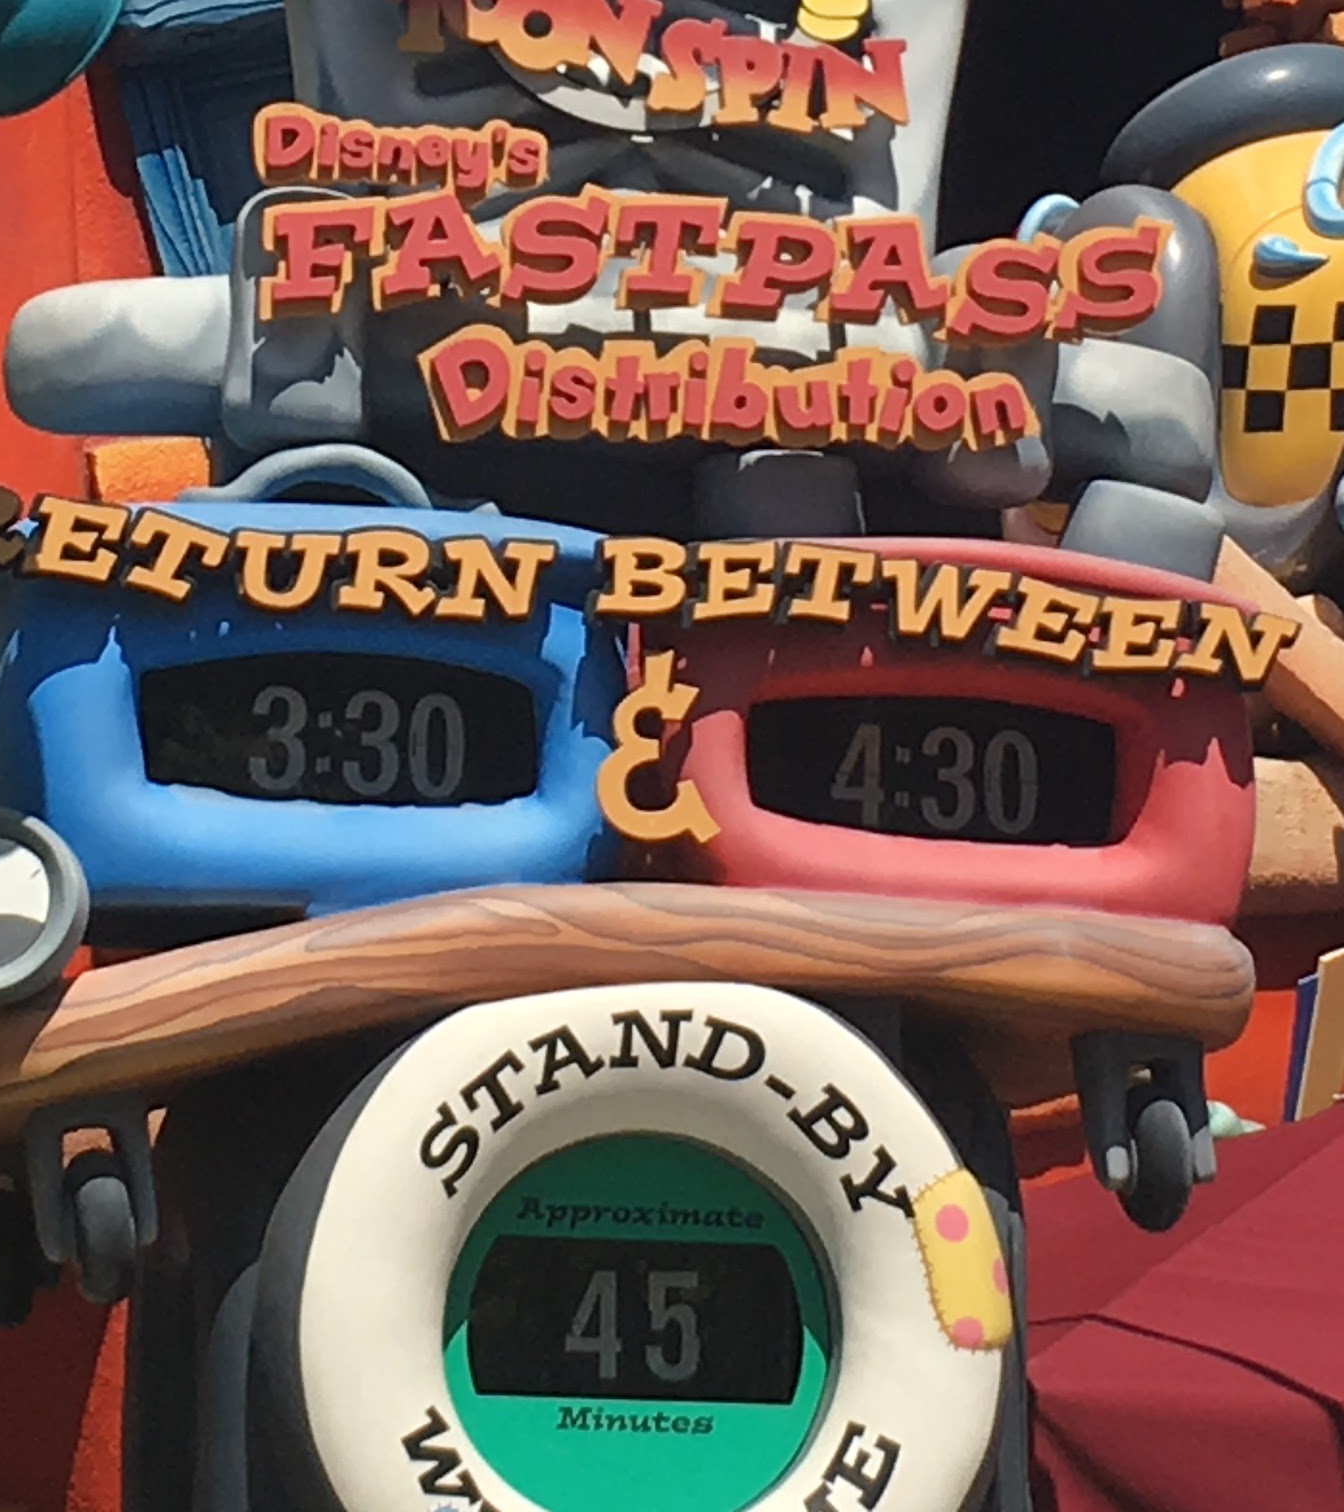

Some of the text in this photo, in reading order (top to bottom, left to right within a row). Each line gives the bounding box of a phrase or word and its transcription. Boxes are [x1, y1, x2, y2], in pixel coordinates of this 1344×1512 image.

[647, 17, 910, 133] SPIN
[256, 105, 548, 192] Disney's
[260, 186, 1173, 341] FASTPASS
[422, 326, 1039, 448] Distribution
[594, 537, 1301, 686] BETWEEN
[248, 684, 466, 799] 3:30
[596, 648, 722, 844] &
[831, 722, 1039, 836] 4:30
[419, 1008, 915, 1219] STAND-BY
[516, 1196, 765, 1230] Approximate
[564, 1270, 701, 1382] 45
[556, 1406, 714, 1435] Minutes
